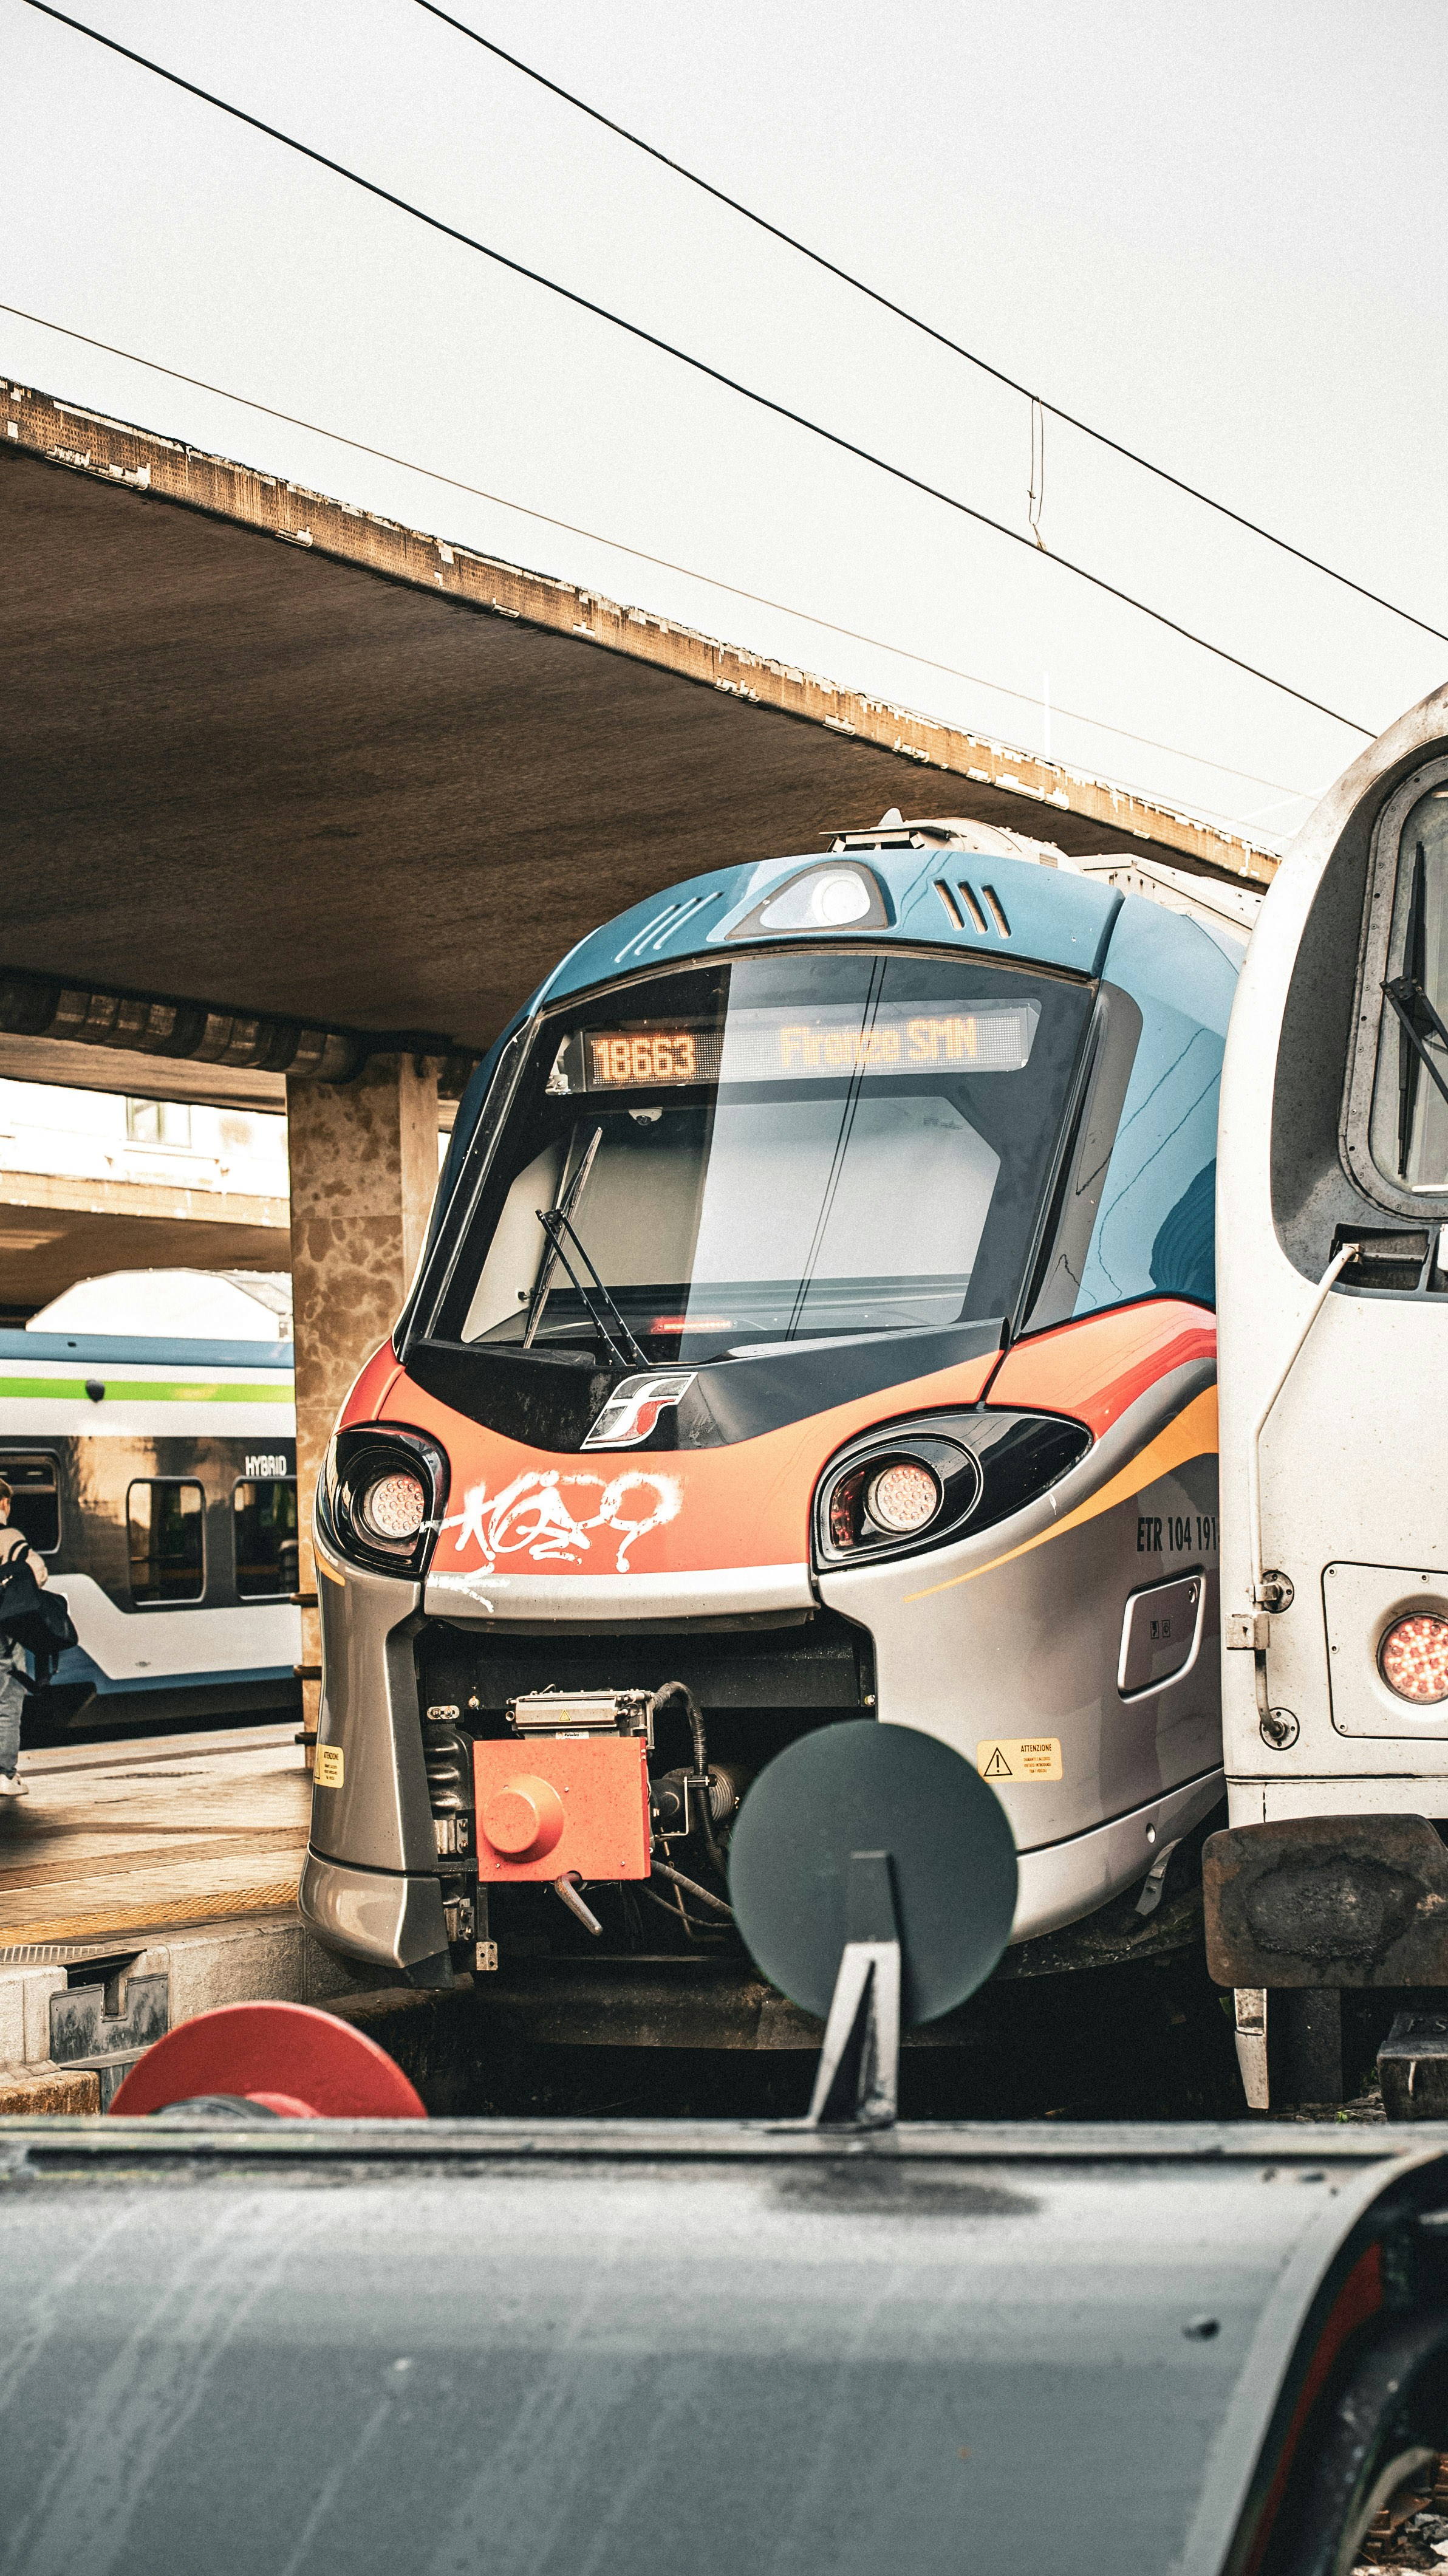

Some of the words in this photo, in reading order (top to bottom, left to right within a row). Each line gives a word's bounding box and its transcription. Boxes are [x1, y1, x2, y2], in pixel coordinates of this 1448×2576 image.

[595, 1035, 696, 1080] 18663
[780, 1025, 900, 1067] Firenze
[907, 1016, 976, 1060] SMN
[245, 1455, 287, 1476] HYBRID
[1136, 1516, 1163, 1552] ETR
[1167, 1516, 1192, 1551] 104
[1020, 1744, 1052, 1752] ATTENZIONE
